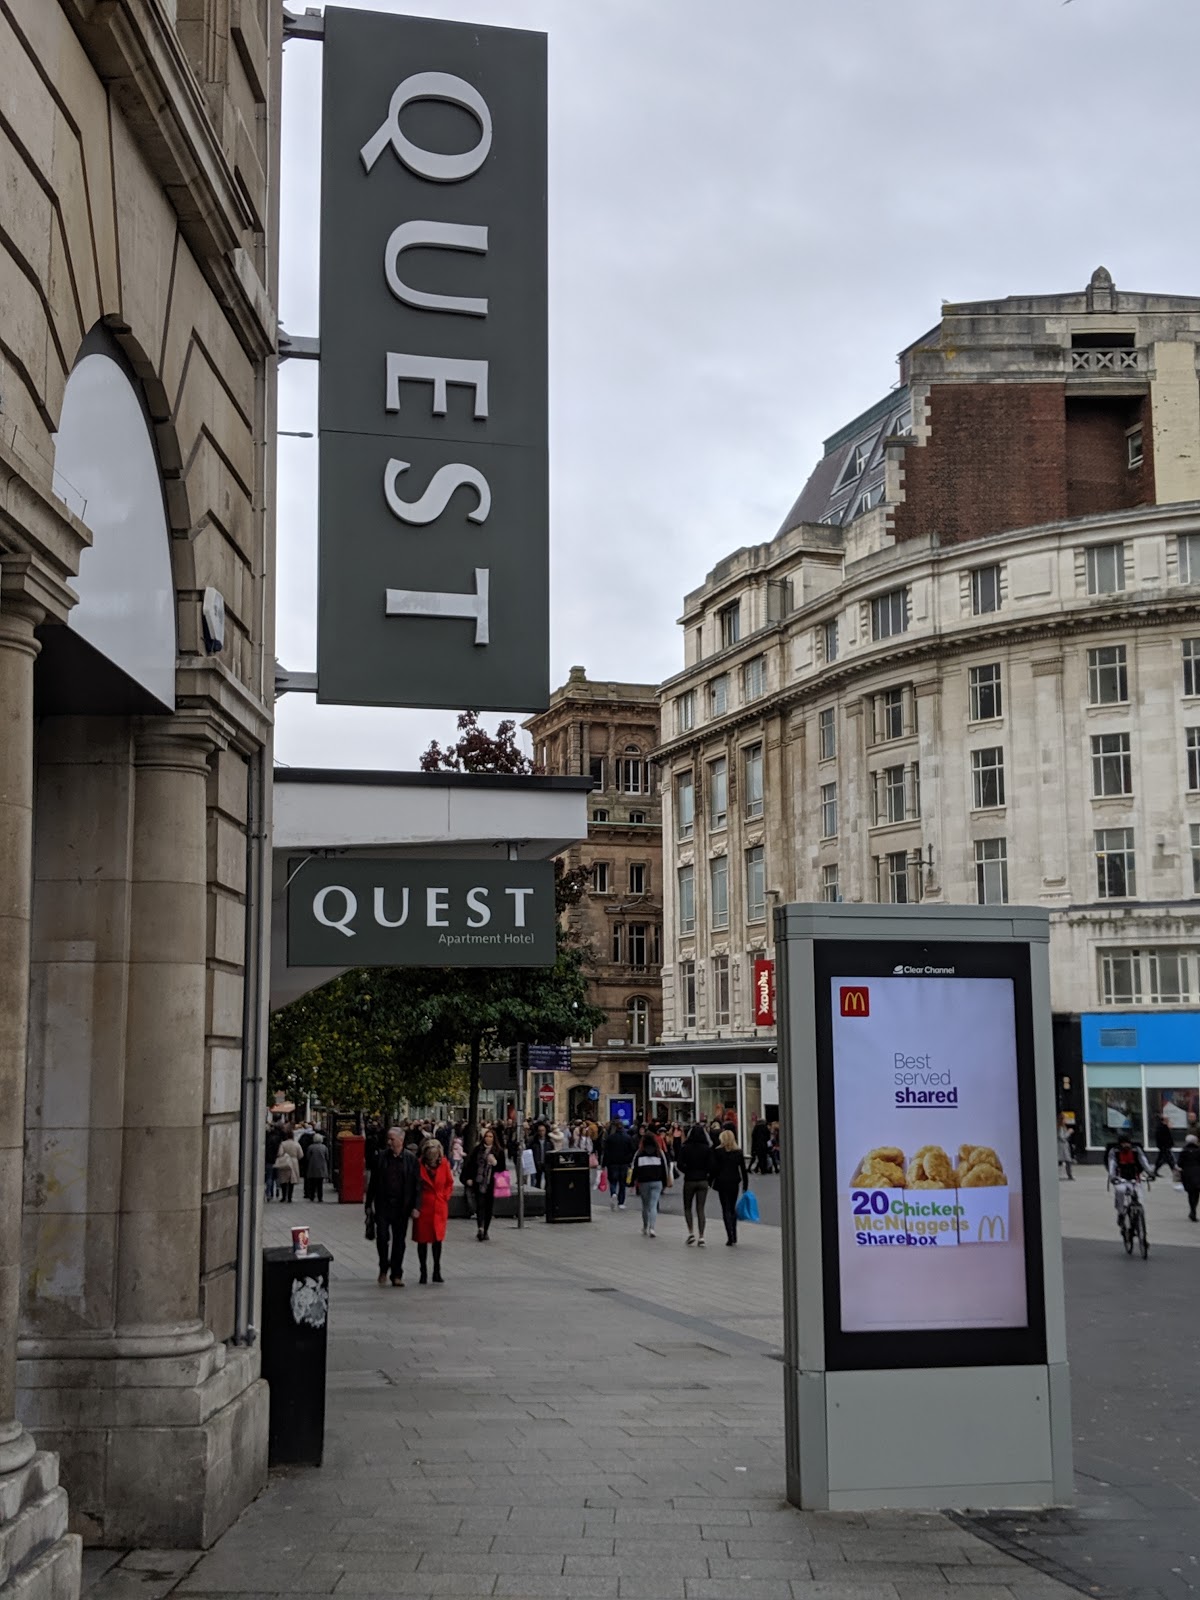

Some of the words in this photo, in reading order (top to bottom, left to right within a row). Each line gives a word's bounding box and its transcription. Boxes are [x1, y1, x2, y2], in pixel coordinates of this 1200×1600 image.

[360, 71, 493, 647] QUEST
[312, 885, 534, 938] QUEST
[438, 933, 501, 946] Apartment
[504, 933, 535, 944] Hotel
[903, 965, 924, 974] Clear
[924, 965, 955, 974] Channel
[894, 1052, 932, 1069] Best
[894, 1069, 951, 1086] served
[895, 1086, 958, 1103] shared
[851, 1190, 889, 1215] 20
[890, 1199, 965, 1216] Chicken
[854, 1214, 970, 1235] McNuggets
[856, 1231, 938, 1246] Sharebox
